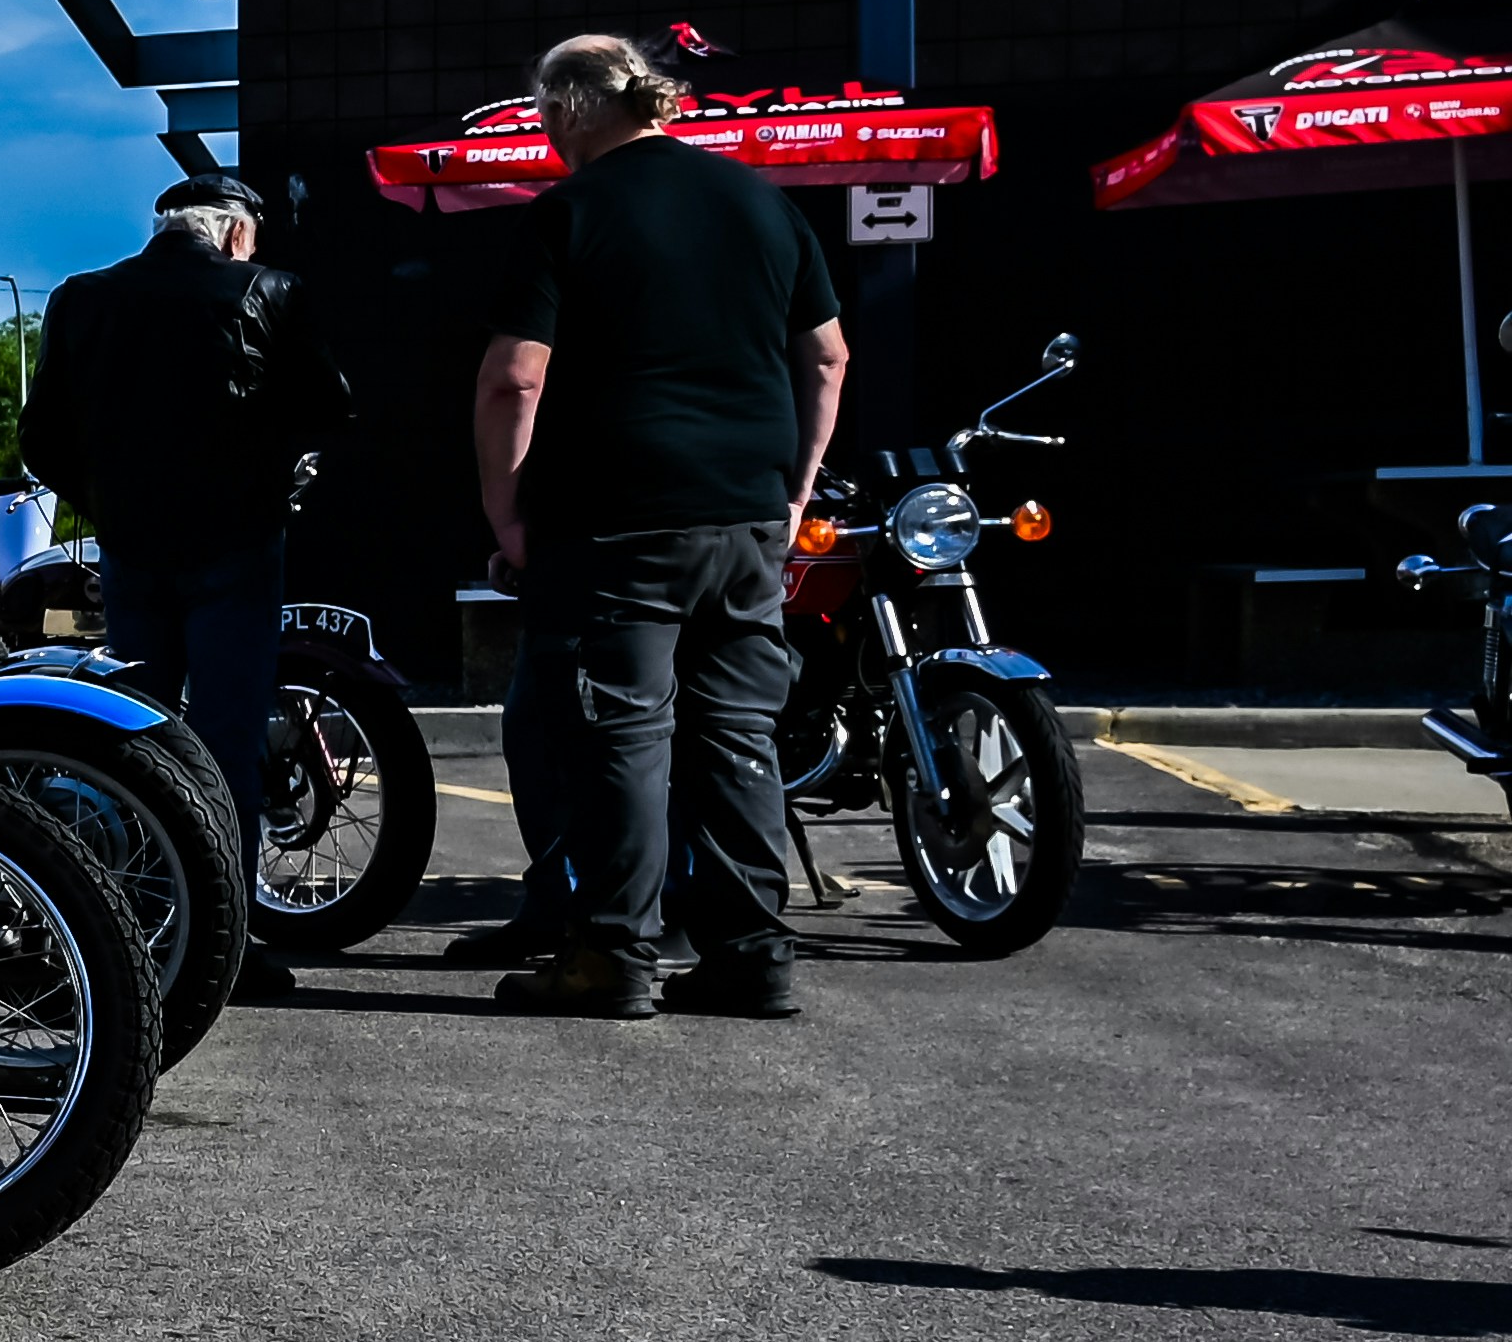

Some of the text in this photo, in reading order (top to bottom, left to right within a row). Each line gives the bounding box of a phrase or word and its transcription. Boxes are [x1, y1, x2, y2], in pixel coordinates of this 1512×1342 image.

[1295, 106, 1389, 129] DUCATI
[1430, 106, 1500, 120] MOTORRAD
[775, 123, 843, 140] YAMAHA
[876, 127, 945, 139] SUZUKI
[466, 145, 548, 163] DUCATI
[315, 609, 355, 636] 437
